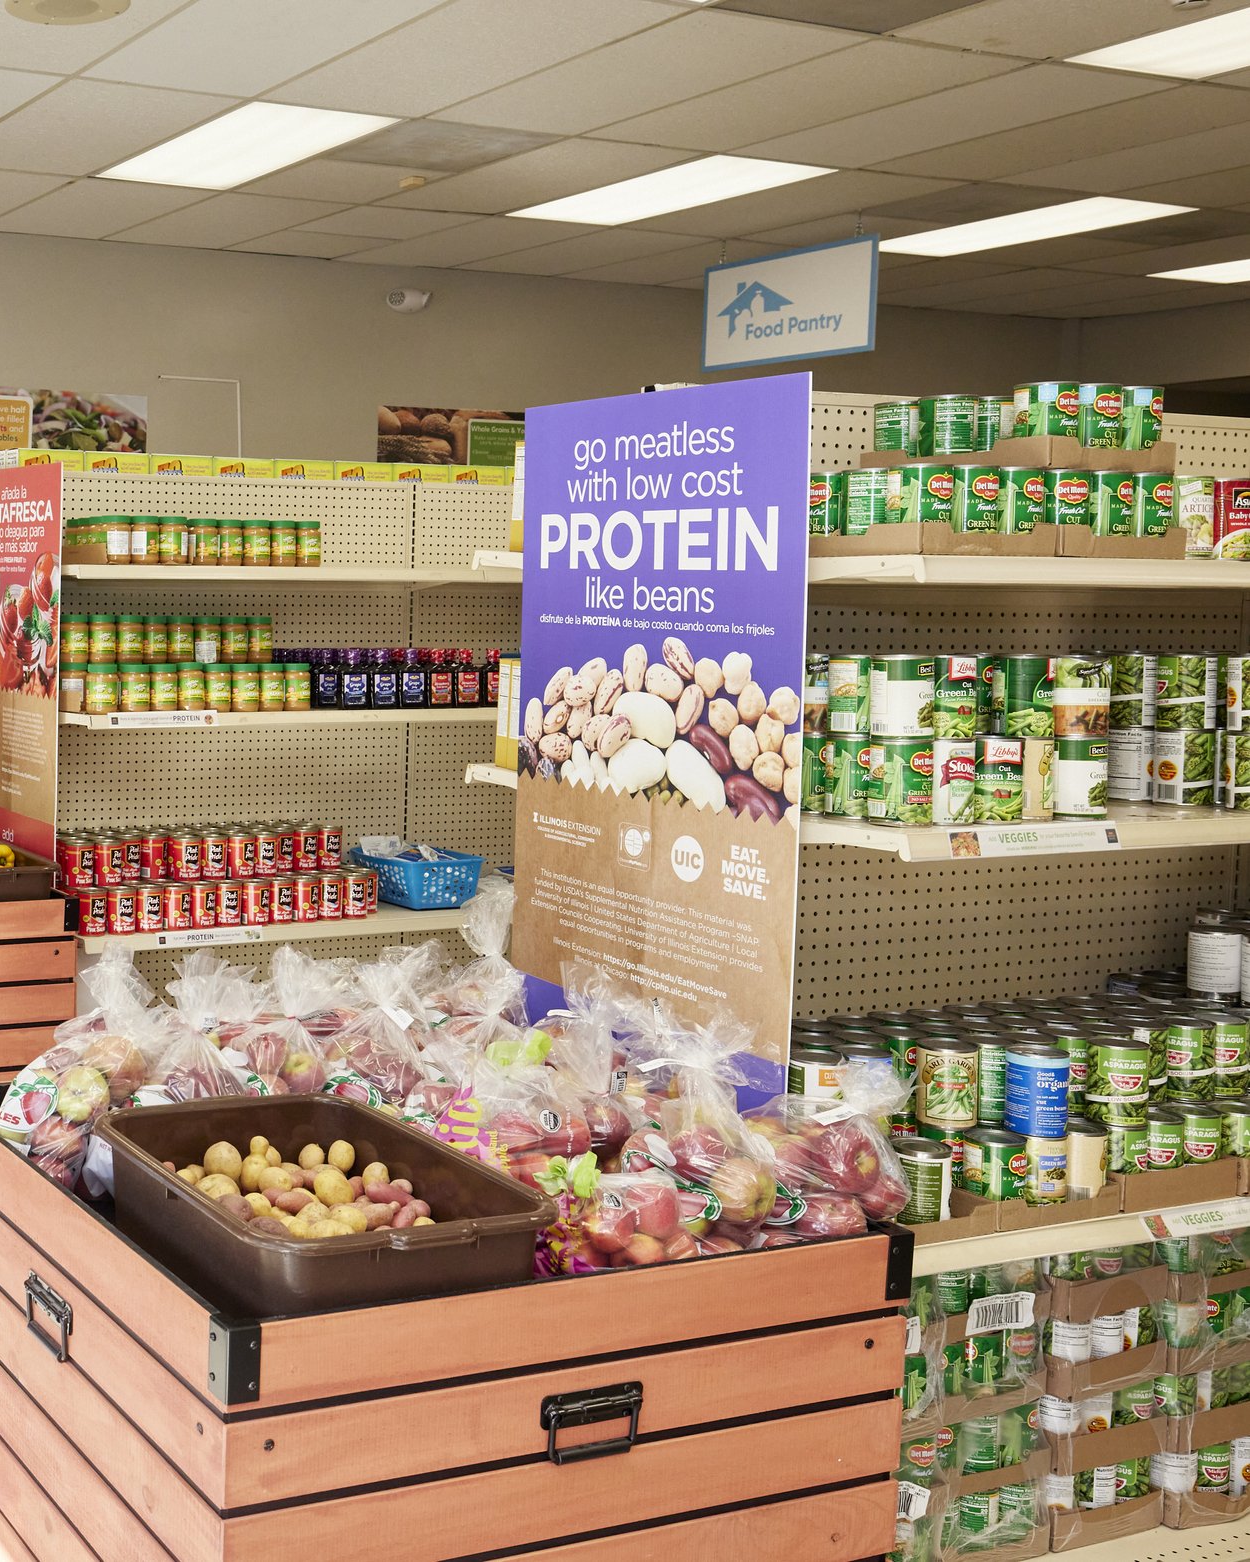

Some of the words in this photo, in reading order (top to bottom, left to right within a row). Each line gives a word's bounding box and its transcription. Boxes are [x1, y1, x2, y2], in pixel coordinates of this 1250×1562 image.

[746, 319, 783, 340] Food
[788, 313, 842, 334] Pantry
[10, 406, 26, 414] half
[7, 415, 25, 424] filled
[9, 425, 24, 433] and
[574, 438, 606, 470] go
[615, 420, 735, 461] meatless
[567, 468, 617, 503] with
[626, 467, 673, 500] low
[681, 461, 744, 498] cost
[1, 486, 20, 500] añada
[21, 485, 27, 499] la
[1066, 516, 1081, 524] CUT
[29, 526, 45, 540] para
[540, 505, 779, 572] PROTEIN
[5, 540, 18, 553] más
[19, 539, 38, 553] sabor
[585, 576, 624, 610] like
[633, 577, 715, 614] beans
[540, 614, 564, 624] disfrute
[564, 615, 574, 625] de
[575, 615, 581, 625] la
[582, 615, 621, 627] PROTEÍNA
[622, 618, 632, 628] de
[633, 618, 650, 630] bajo
[651, 620, 673, 630] costo
[674, 621, 705, 632] cuando
[706, 624, 730, 633] coma
[731, 623, 744, 634] los
[746, 624, 775, 637] frijoles
[936, 689, 971, 698] Green
[991, 742, 1019, 757] Libby's
[949, 759, 975, 773] Stoke
[974, 772, 1005, 781] Green
[540, 815, 567, 828] ILLINOIS
[568, 822, 601, 836] EXTENSION
[2, 828, 14, 843] add
[998, 831, 1039, 844] VEGGIES
[674, 850, 701, 869] UIC
[731, 845, 762, 865] EAT.
[721, 860, 770, 884] MOVE.
[723, 877, 767, 901] SAVE.
[535, 877, 554, 889] funded
[555, 883, 562, 892] by
[563, 885, 584, 897] USDA's
[585, 892, 627, 909] Supplemental
[629, 905, 658, 918] Nutrition
[660, 913, 696, 929] Assistance
[698, 923, 730, 939] Program
[541, 868, 551, 877] This
[553, 871, 581, 885] institution
[589, 882, 597, 890] an
[598, 885, 615, 895] equal
[616, 890, 654, 906] opportunity
[688, 908, 703, 919] This
[705, 913, 735, 927] material
[736, 921, 752, 932] was
[536, 888, 562, 903] University
[564, 897, 570, 905] of
[571, 899, 590, 910] Illinois
[594, 906, 615, 918] United
[615, 912, 636, 924] States
[637, 918, 677, 936] Department
[679, 930, 688, 939] of
[689, 932, 730, 950] Agriculture
[736, 945, 758, 958] Local
[531, 897, 558, 912] Extension
[558, 906, 583, 920] Councils
[624, 925, 657, 941] University
[659, 935, 667, 944] of
[668, 938, 690, 952] Illinois
[692, 946, 728, 962] Extension
[730, 957, 763, 973] provides
[553, 936, 571, 948] Illinois
[559, 918, 575, 930] equal
[576, 924, 617, 942] opportunities
[618, 935, 624, 943] in
[625, 940, 657, 954] programs
[658, 948, 671, 958] and
[673, 953, 719, 973] employment.
[925, 1058, 946, 1074] EARLY
[1103, 1060, 1147, 1070] ASPARAGUS
[1181, 1211, 1223, 1225] VEGGIES
